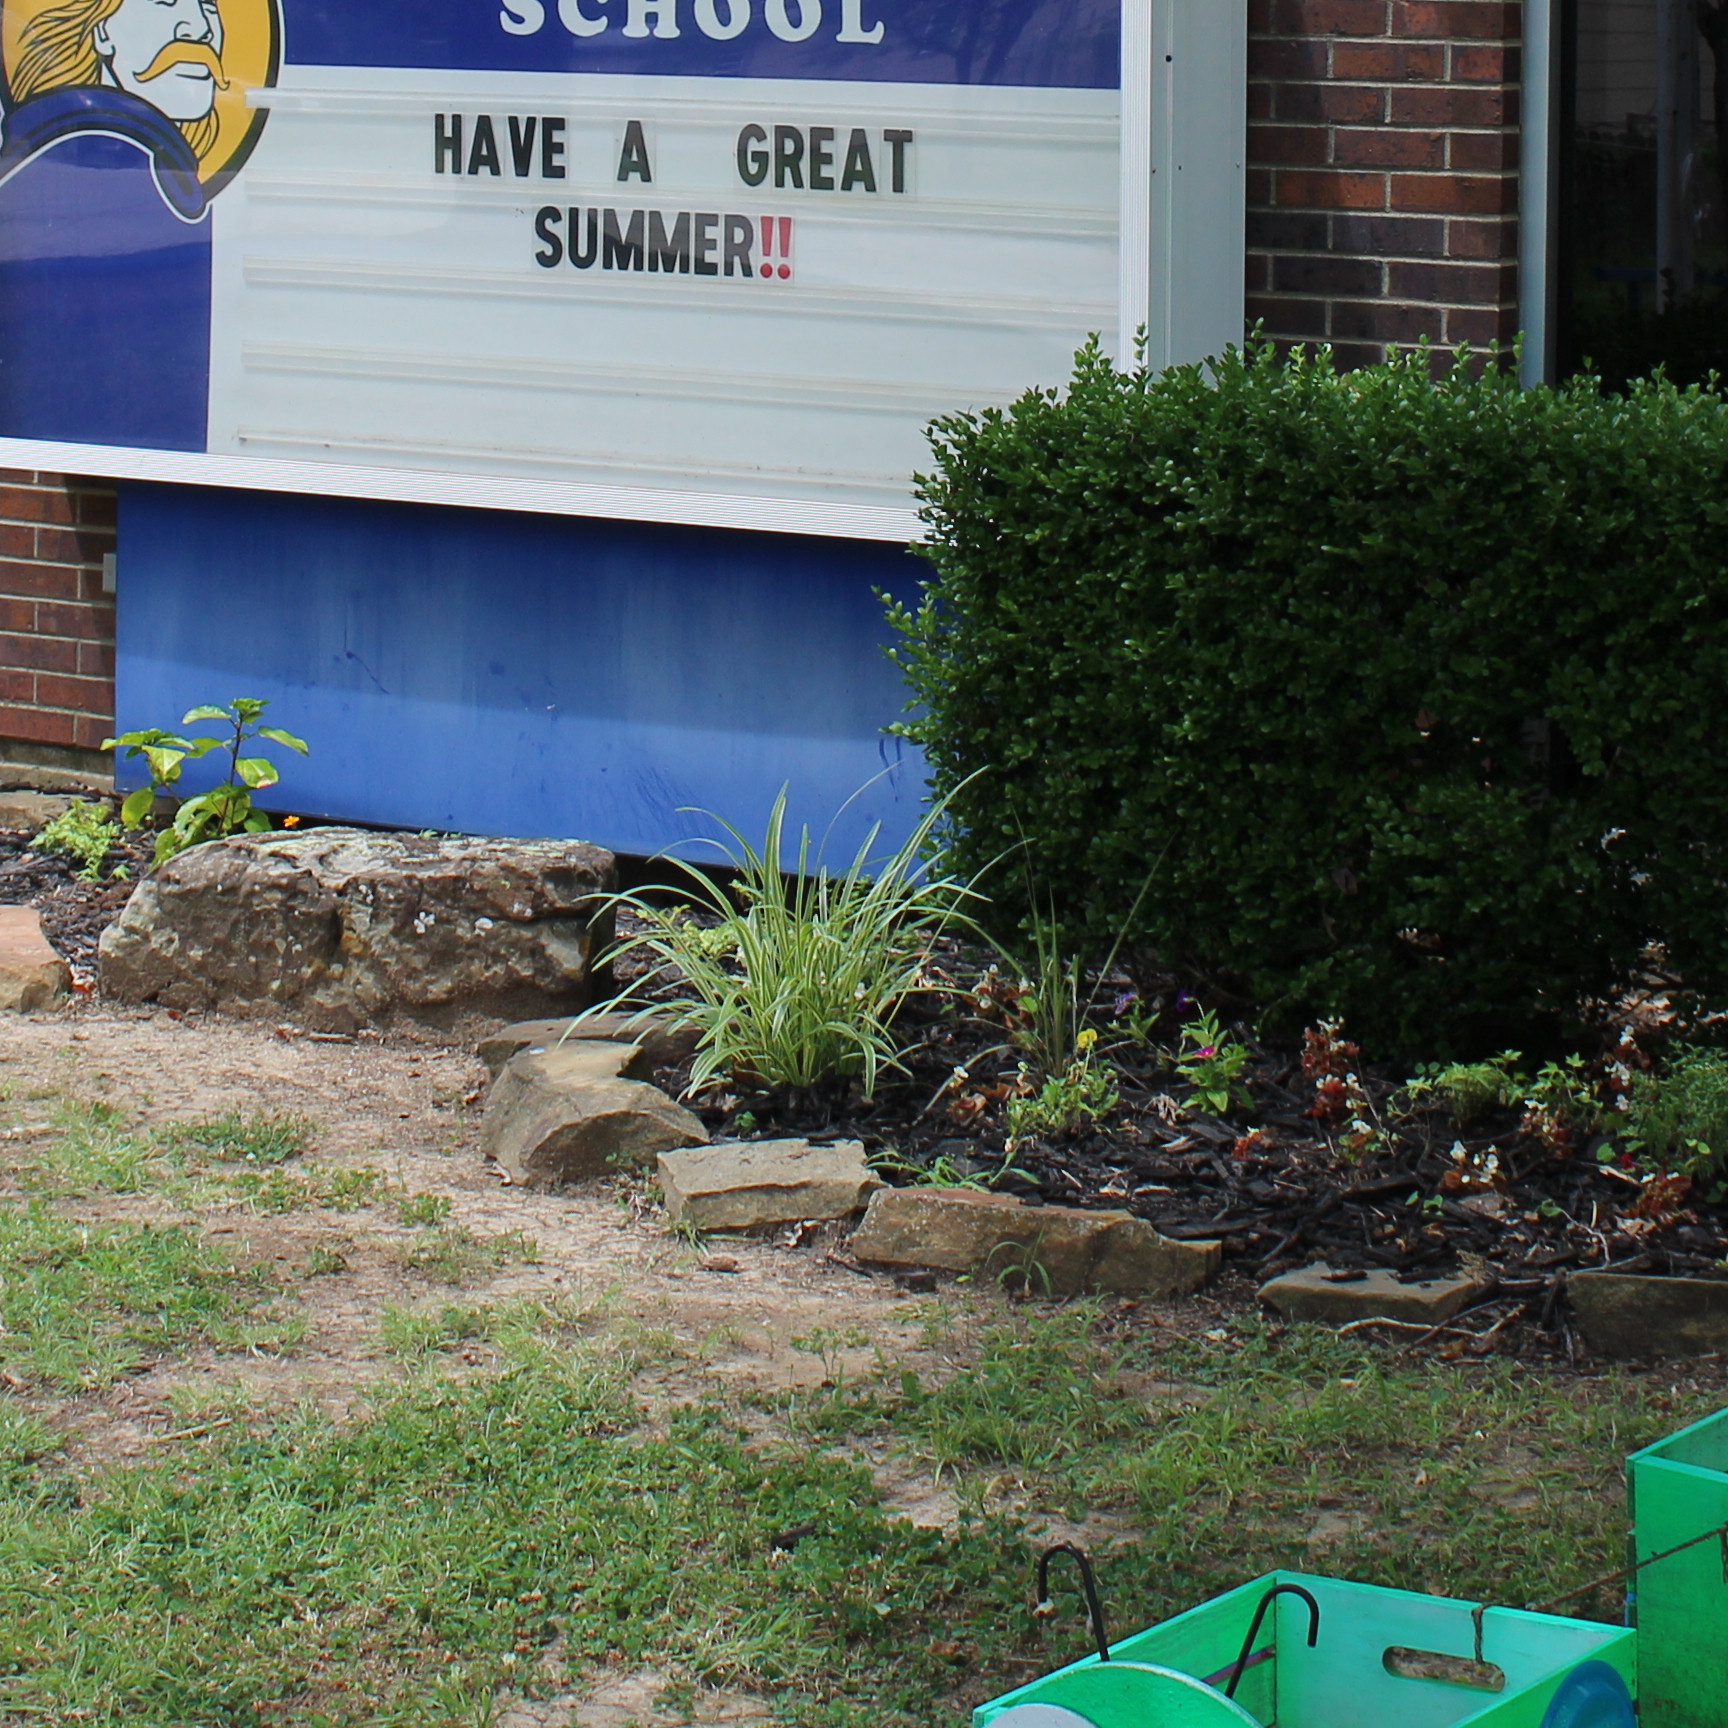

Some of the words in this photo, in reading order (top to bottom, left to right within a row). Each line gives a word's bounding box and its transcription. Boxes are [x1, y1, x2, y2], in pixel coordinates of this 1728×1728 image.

[434, 113, 567, 179] HAVE
[616, 120, 652, 183] A
[736, 123, 914, 194] GREAT
[534, 205, 793, 280] SUMMER!!
